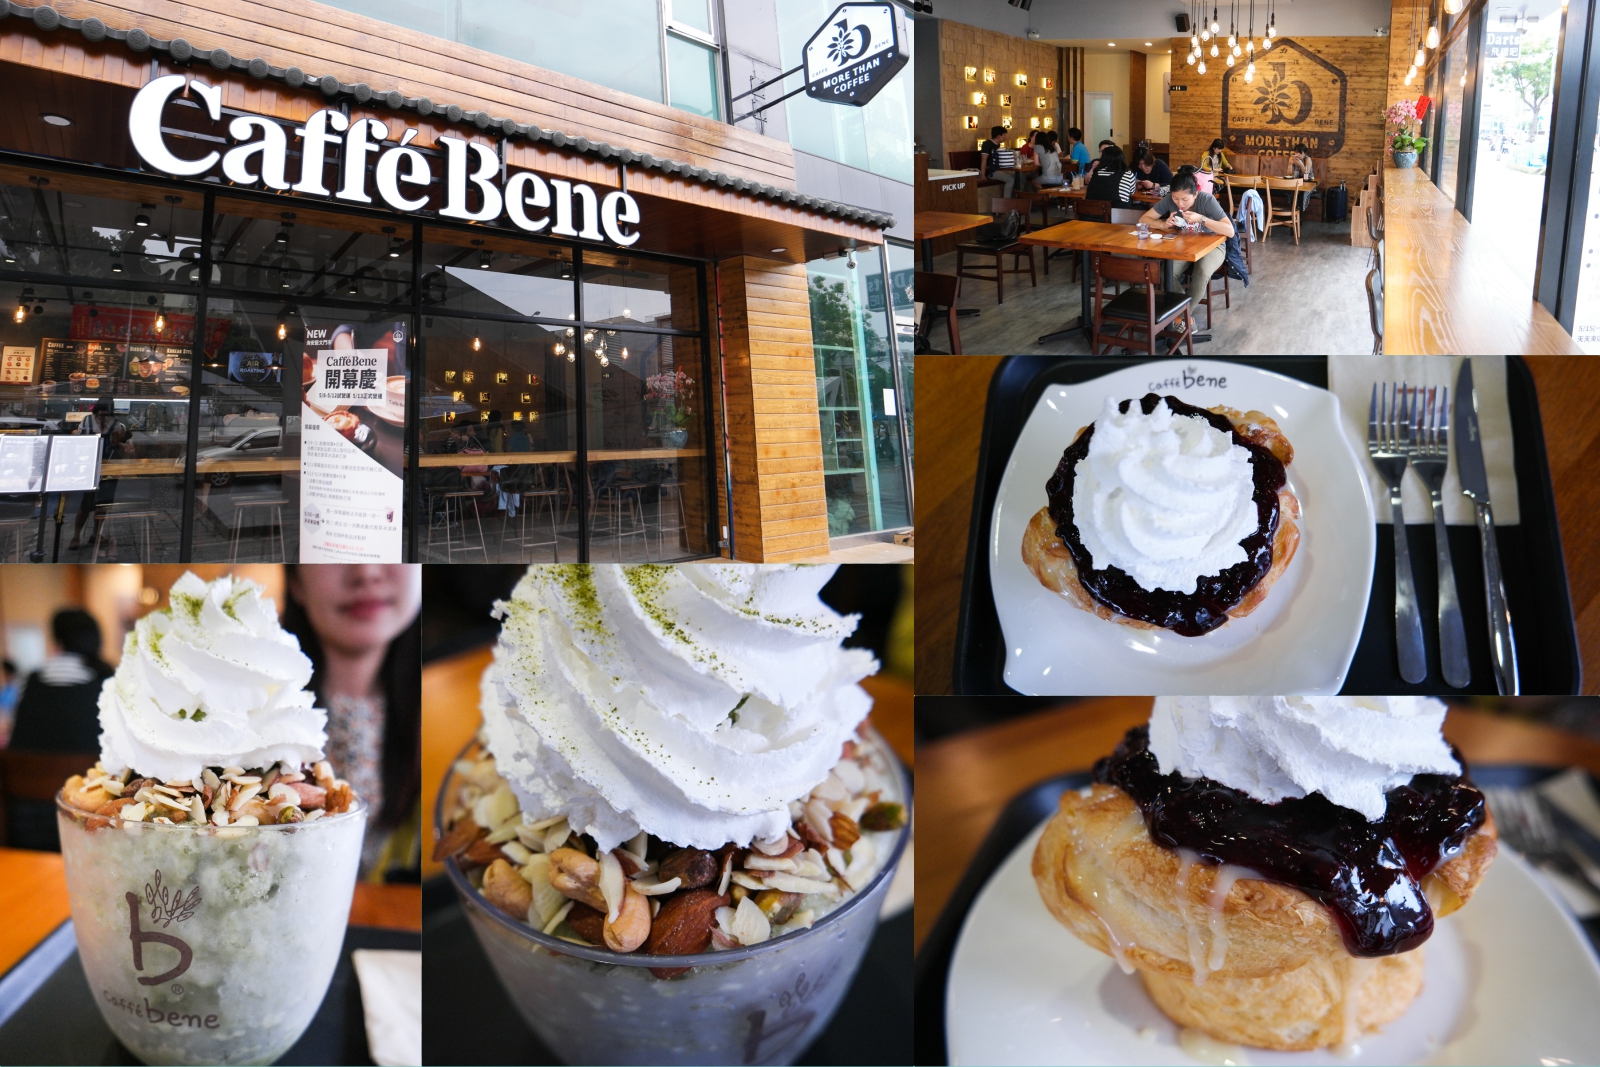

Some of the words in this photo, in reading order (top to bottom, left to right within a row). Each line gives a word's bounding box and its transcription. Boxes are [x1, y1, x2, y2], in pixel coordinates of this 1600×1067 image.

[1486, 33, 1520, 45] Darts
[823, 71, 850, 89] MORE
[853, 58, 880, 76] THAN
[834, 73, 870, 95] COFFEE
[1245, 134, 1280, 148] MORE
[1284, 136, 1319, 149] THAN
[307, 330, 326, 338] NEW
[325, 368, 377, 390] 開幕慶
[144, 998, 220, 1029] bene
